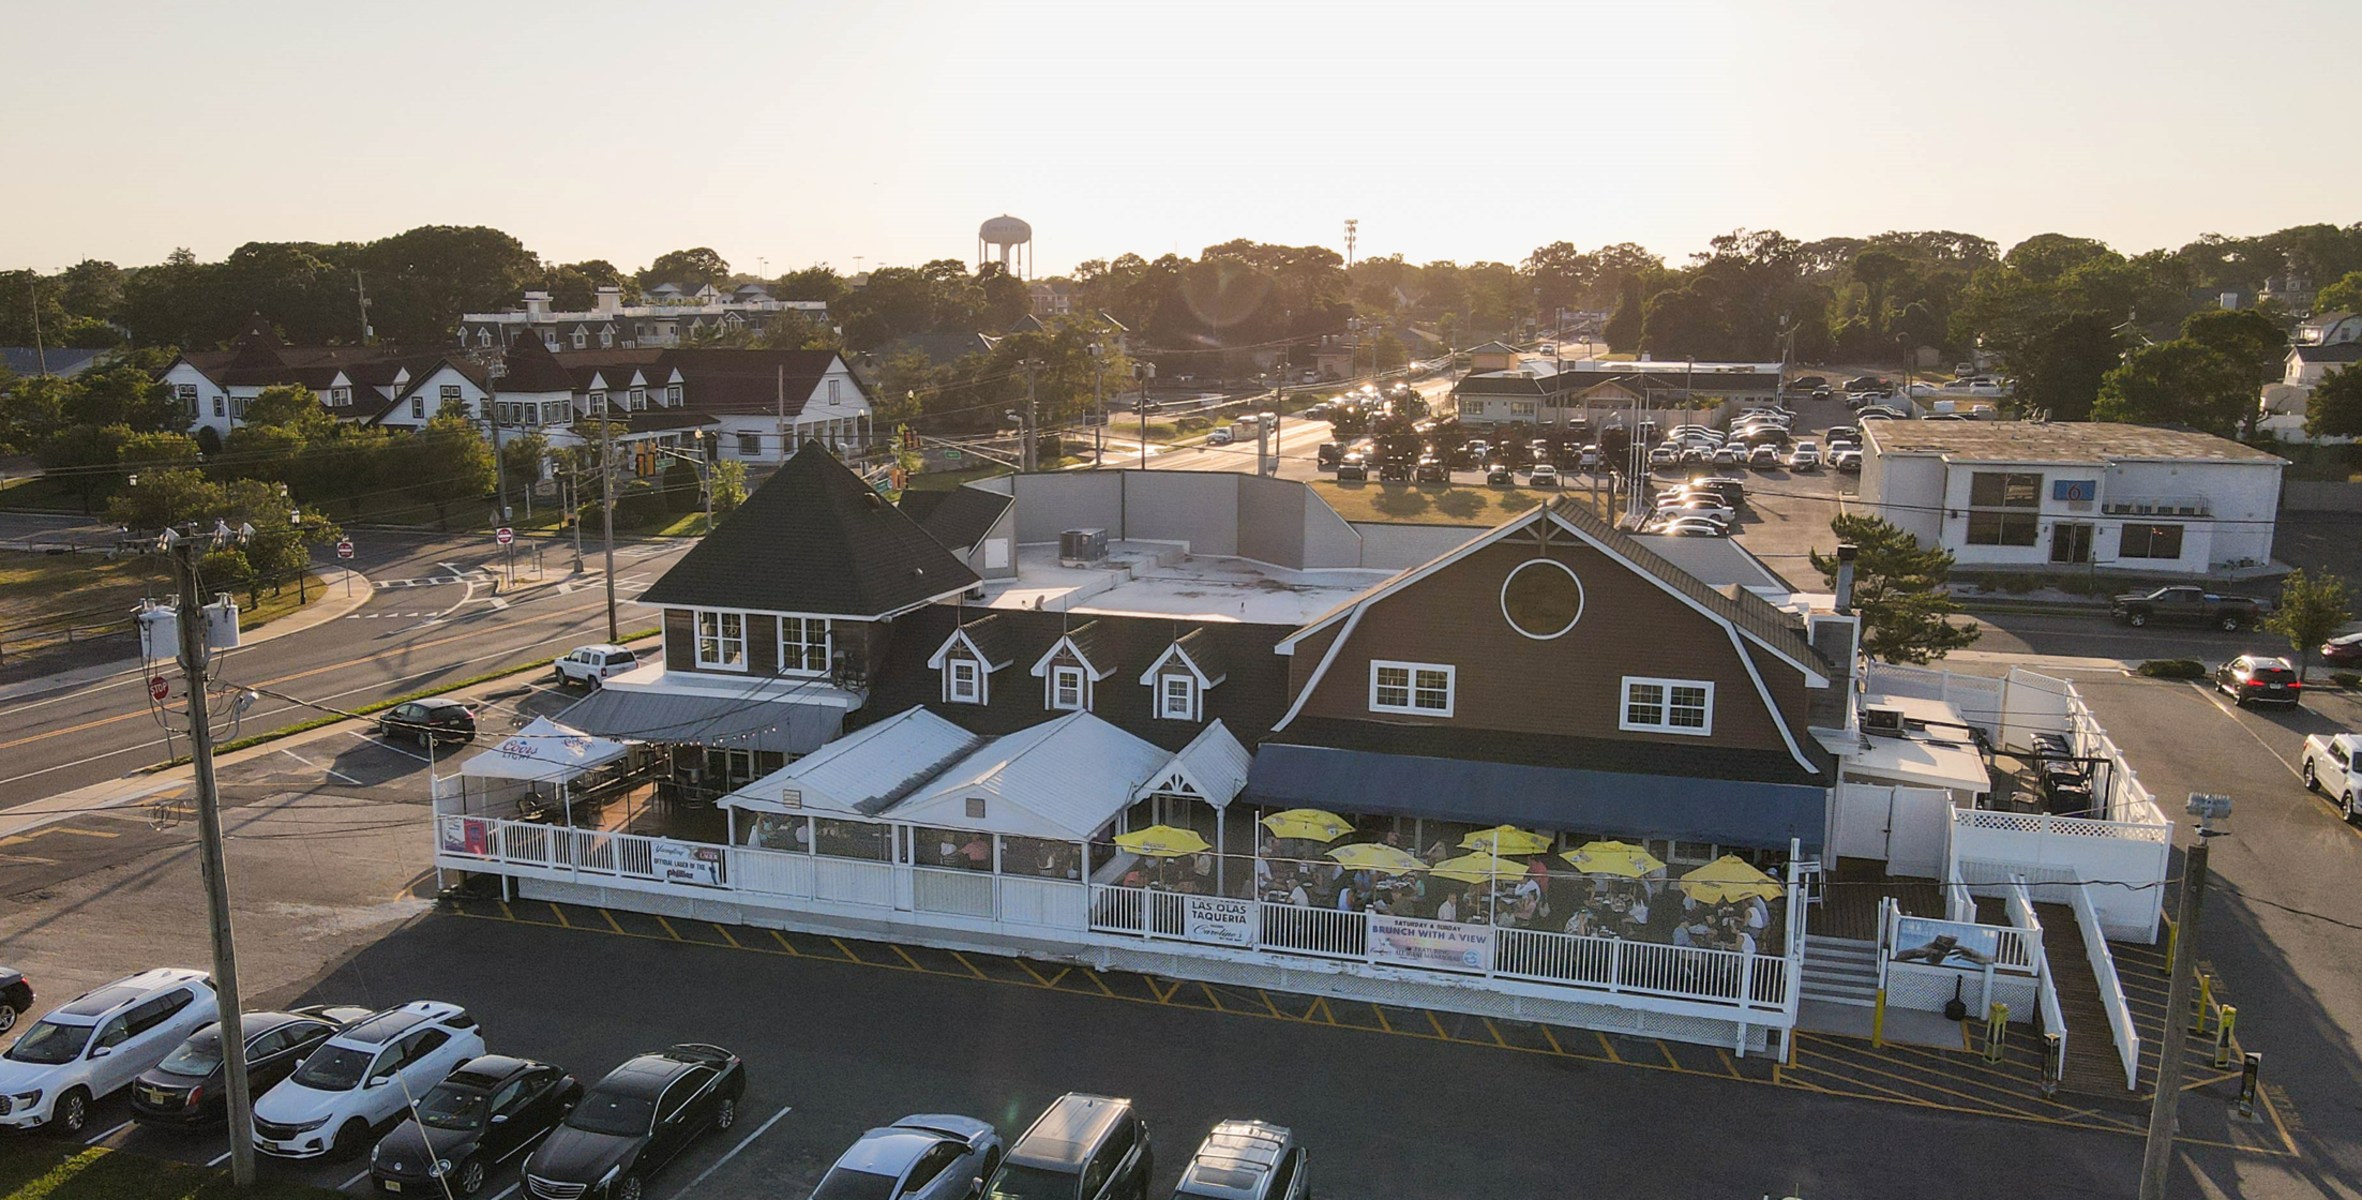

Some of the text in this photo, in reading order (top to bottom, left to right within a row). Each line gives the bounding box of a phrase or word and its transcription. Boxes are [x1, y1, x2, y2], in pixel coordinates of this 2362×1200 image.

[2067, 483, 2081, 501] 6
[150, 682, 168, 695] STOP
[502, 740, 538, 755] Coors
[1192, 901, 1246, 914] LAS OLAS
[1192, 910, 1246, 924] TAQUERIA
[1394, 919, 1428, 929] SATURDAY
[1436, 924, 1461, 932] SUNDAY
[1372, 925, 1415, 936] BRUNCH
[1417, 929, 1445, 939] WITH
[1459, 934, 1487, 944] VIEW
